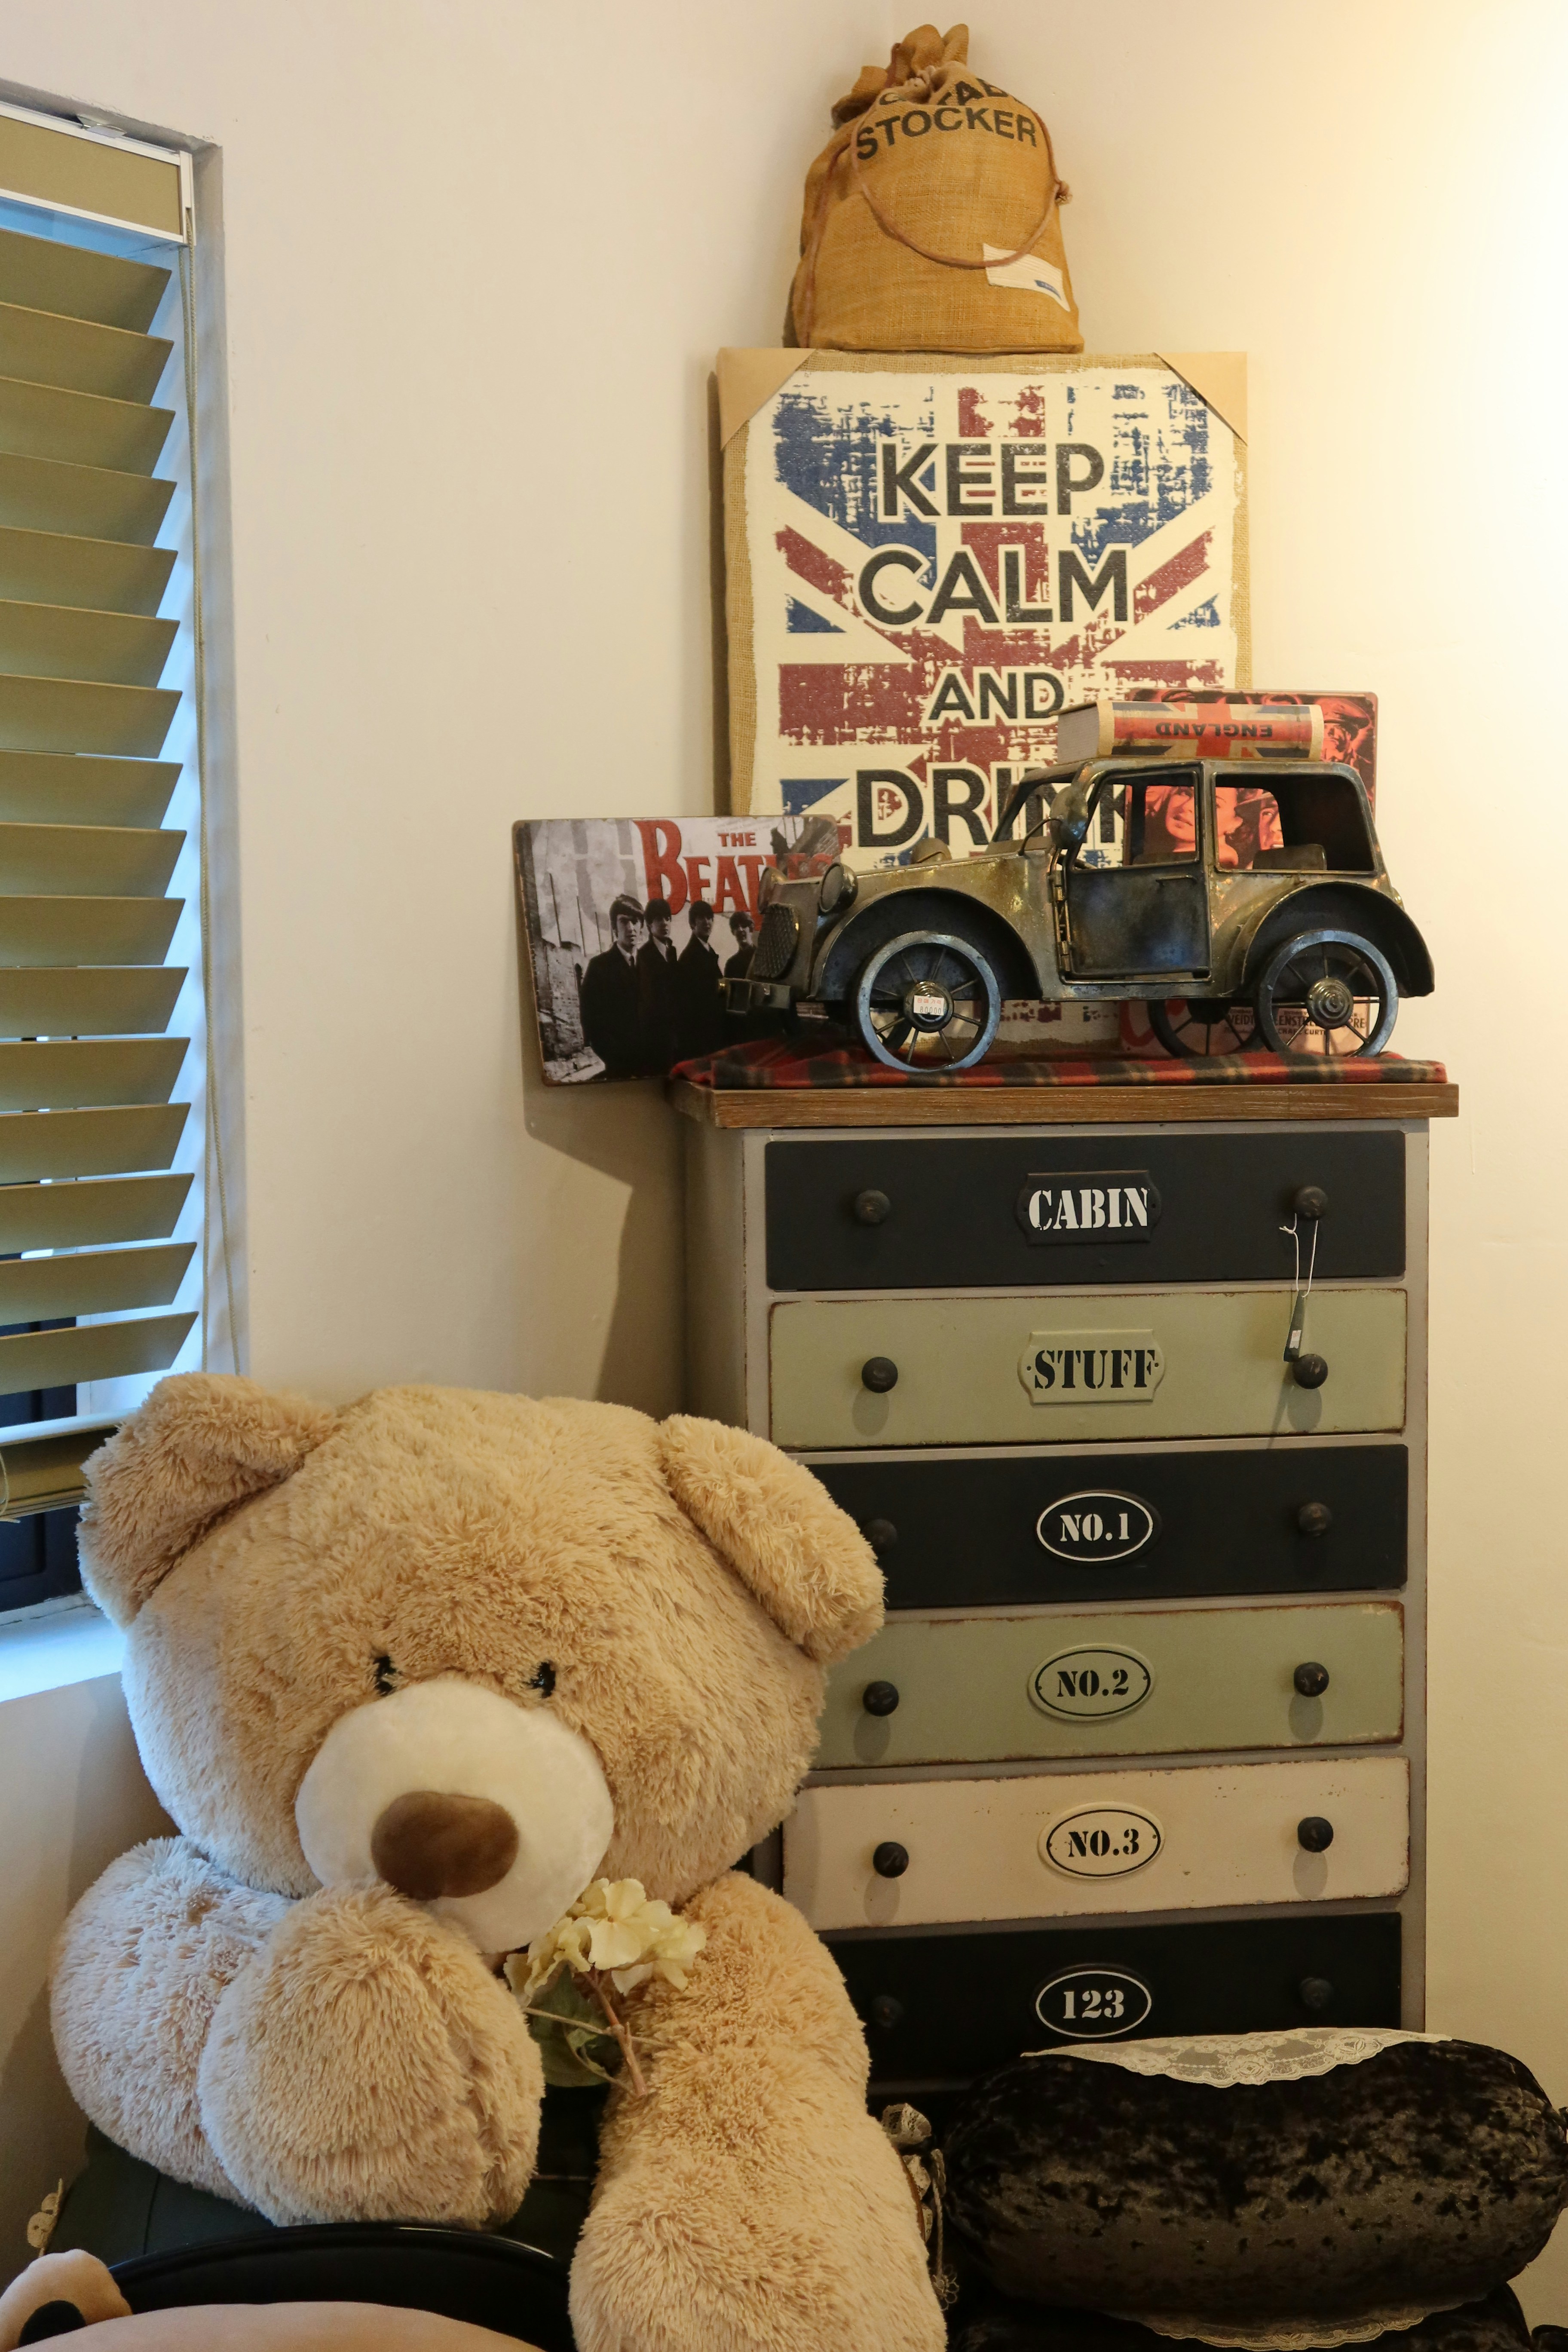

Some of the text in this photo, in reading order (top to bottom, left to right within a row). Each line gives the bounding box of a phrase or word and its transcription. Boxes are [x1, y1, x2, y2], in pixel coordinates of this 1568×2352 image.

[856, 107, 1036, 160] STOCKER
[882, 443, 1103, 516] KEEP
[861, 549, 1128, 625] CALM
[929, 671, 1065, 720] AND
[1155, 722, 1273, 738] ENGLAND
[717, 832, 756, 847] THE
[1029, 1187, 1148, 1231] CABIN
[1034, 1350, 1155, 1389] STUFF
[1060, 1513, 1130, 1542] NO.1
[1057, 1669, 1129, 1697] NO.2
[1068, 1828, 1139, 1857] NO.3
[1063, 1990, 1124, 2018] 123
